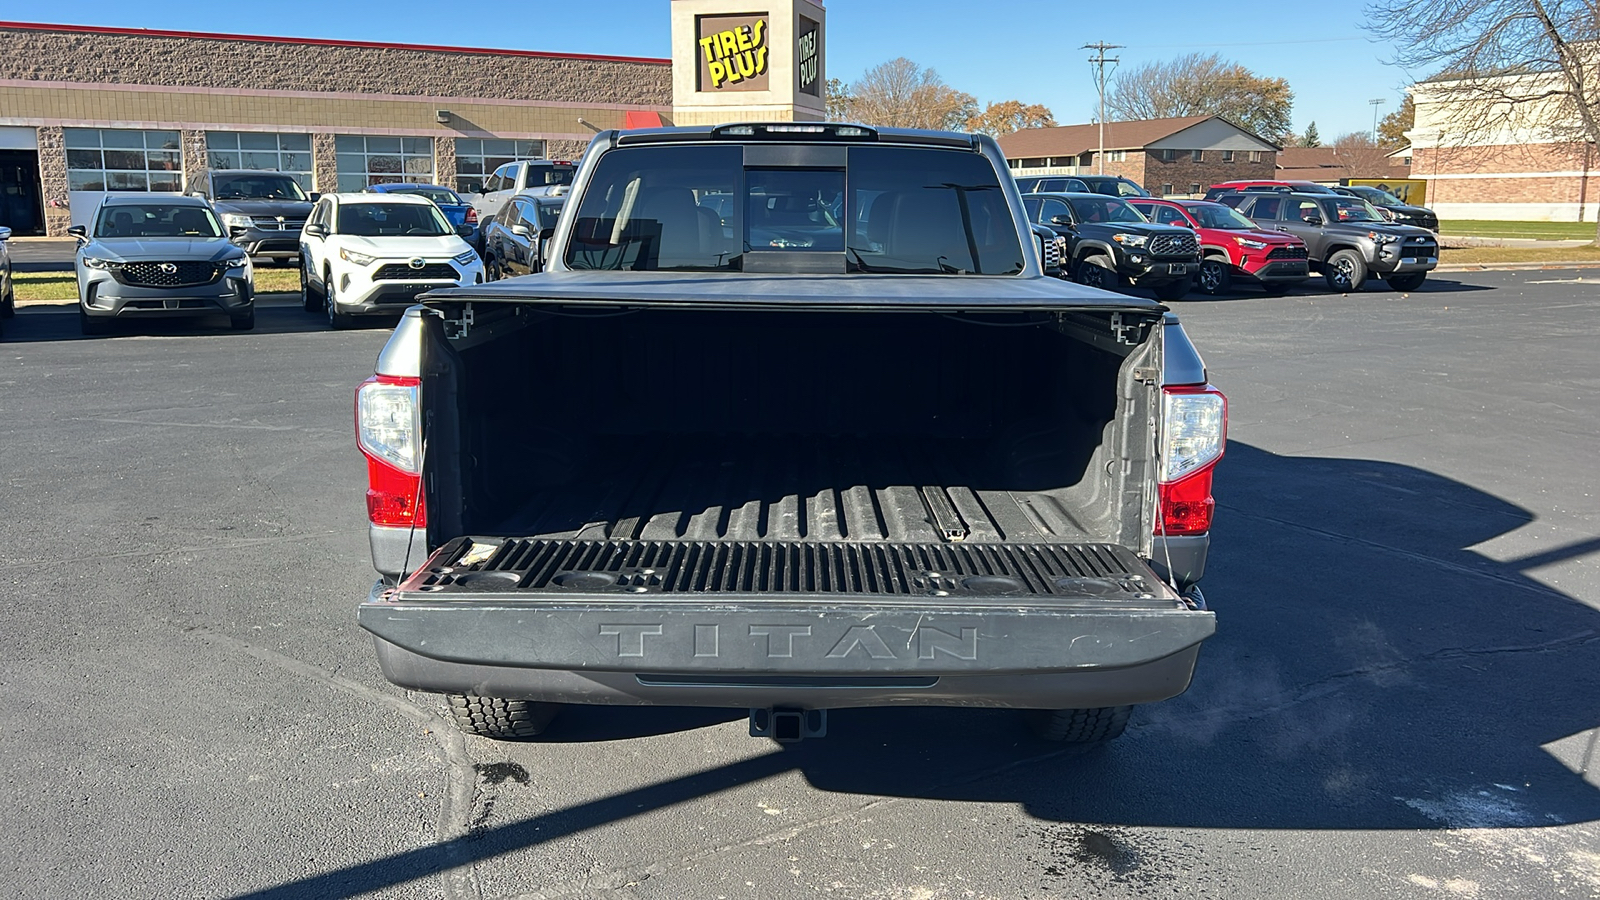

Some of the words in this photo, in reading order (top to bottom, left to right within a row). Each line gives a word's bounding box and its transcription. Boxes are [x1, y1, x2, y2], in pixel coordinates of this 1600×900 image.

[699, 19, 766, 63] TIRES
[798, 29, 817, 63] TIRES
[708, 45, 768, 88] PLUS
[800, 54, 818, 88] PLUS
[599, 623, 978, 660] TITAN
